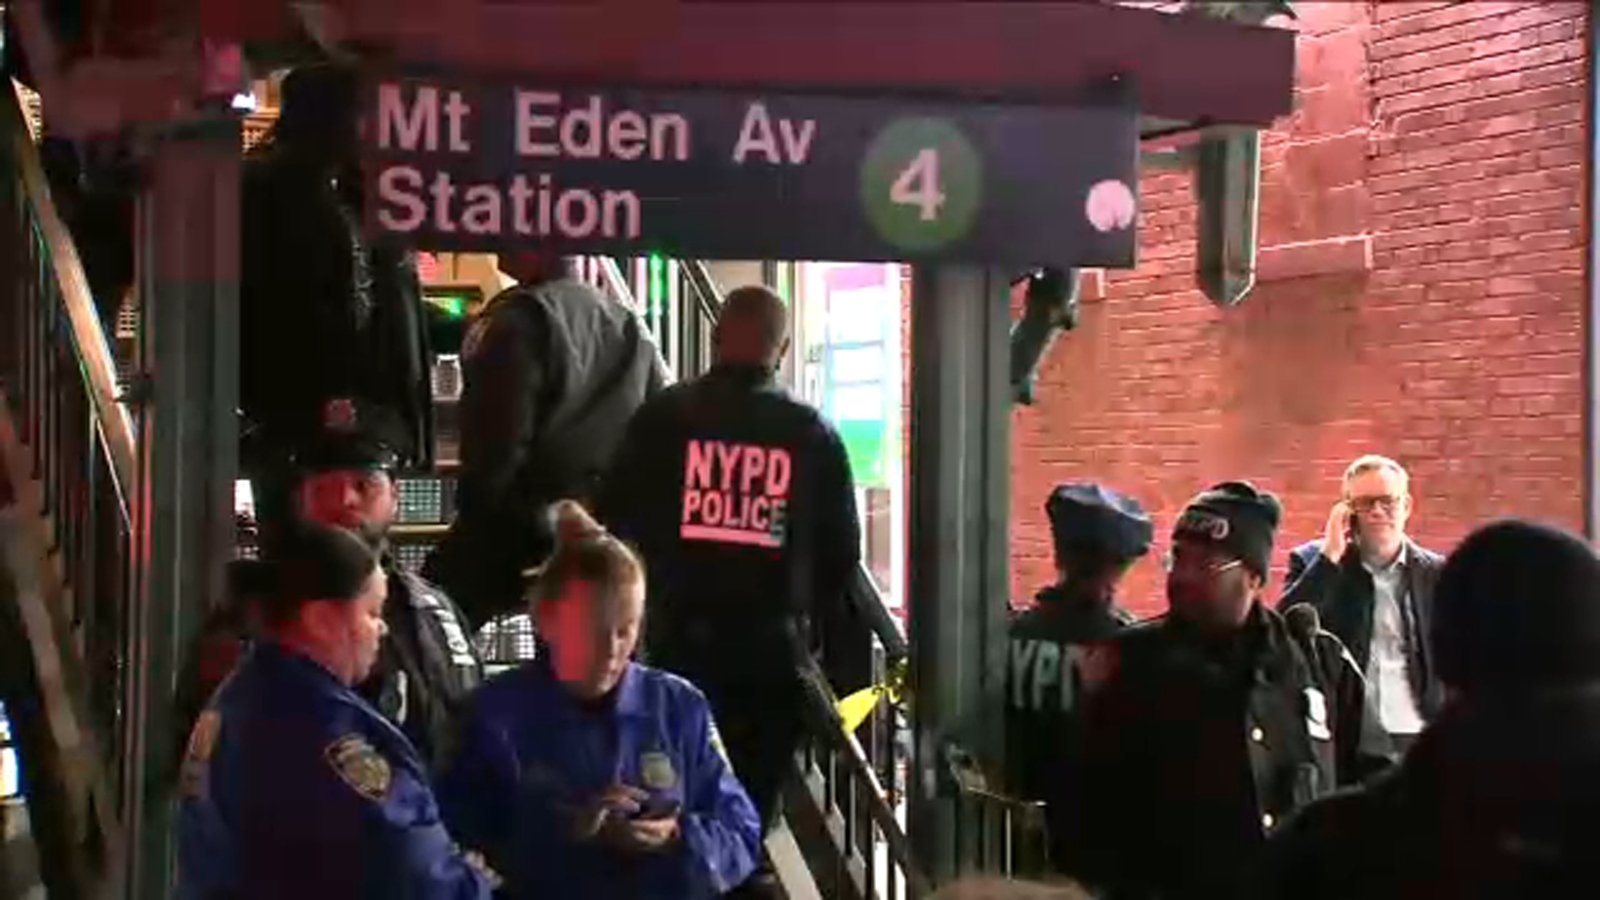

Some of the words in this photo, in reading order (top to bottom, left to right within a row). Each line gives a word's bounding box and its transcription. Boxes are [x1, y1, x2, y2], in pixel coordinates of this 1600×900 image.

[377, 82, 471, 152] Mt
[515, 90, 690, 162] Eden
[732, 102, 817, 165] Av
[377, 165, 641, 240] Station
[889, 148, 946, 222] 4
[684, 438, 792, 497] NYPD
[681, 488, 789, 533] POLICE
